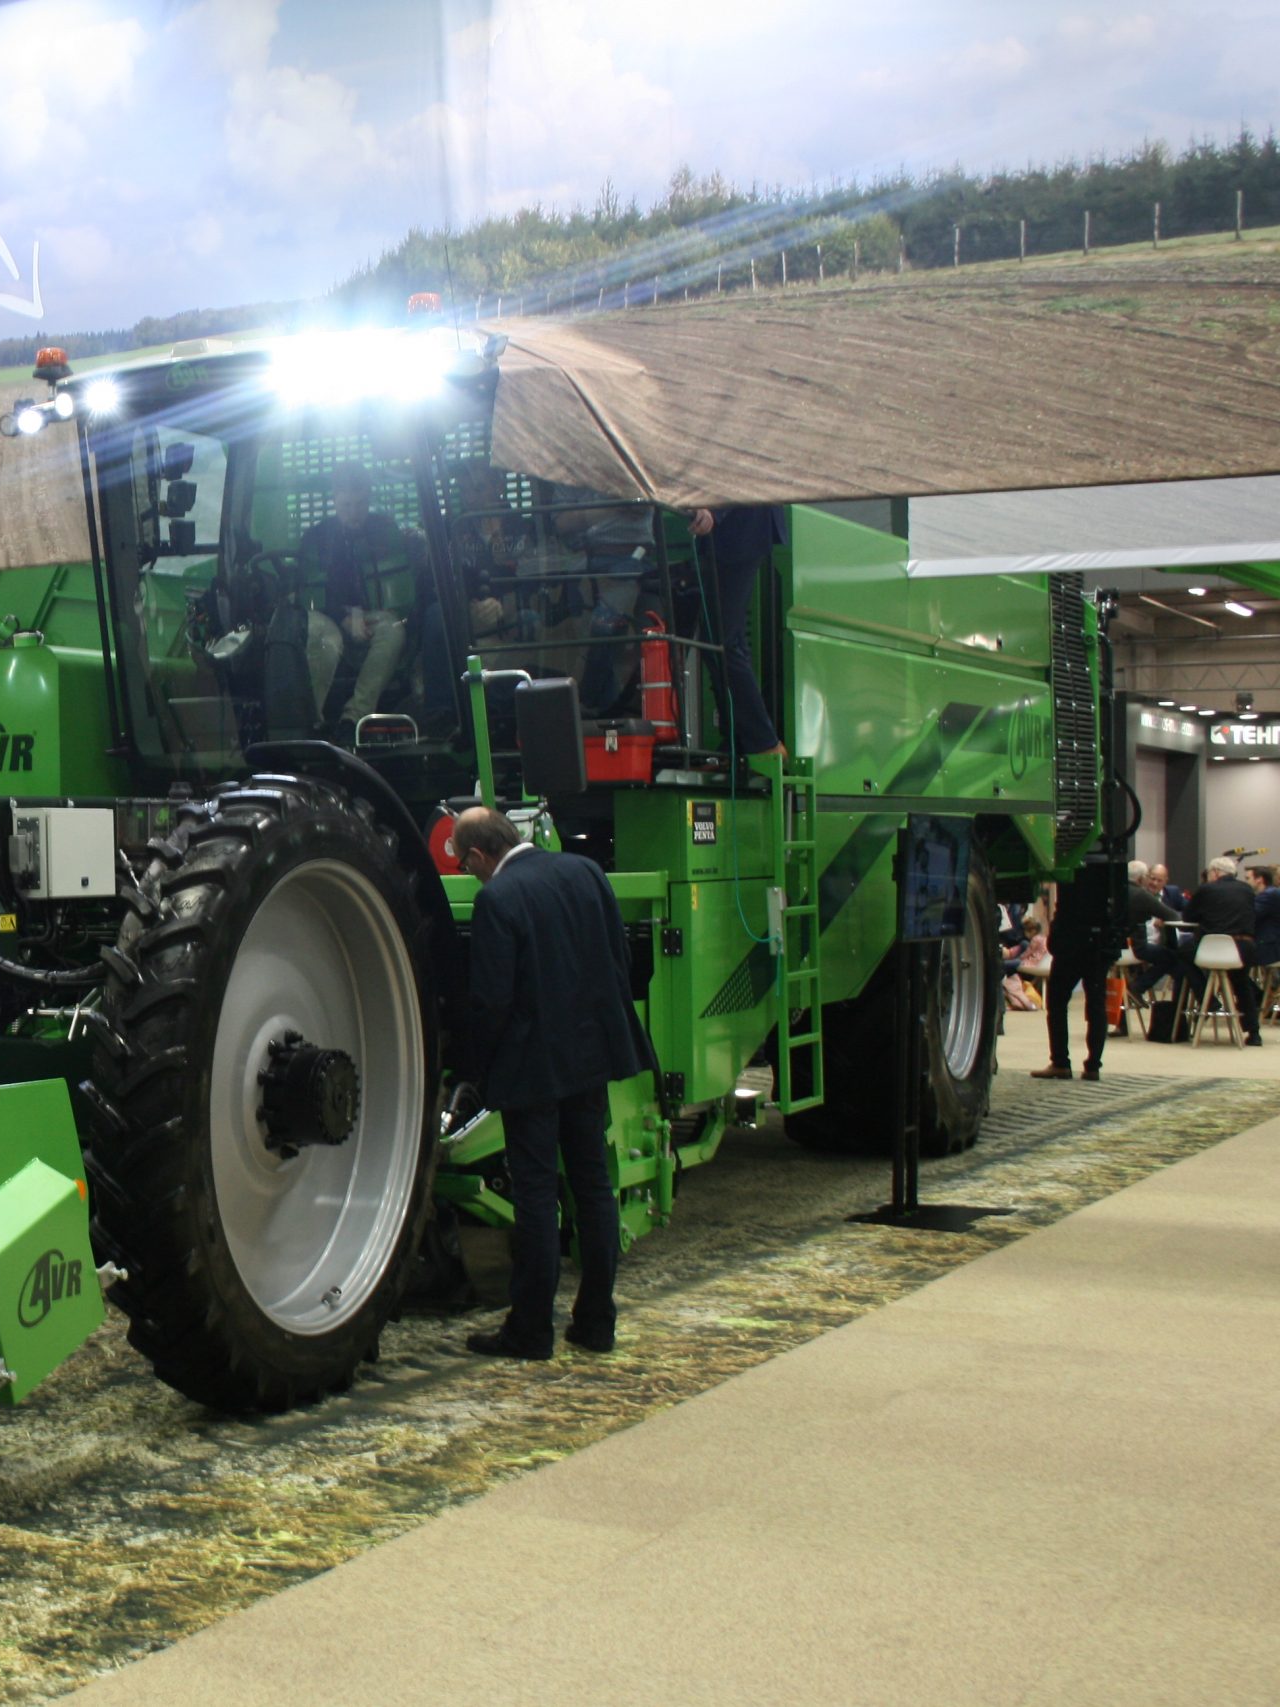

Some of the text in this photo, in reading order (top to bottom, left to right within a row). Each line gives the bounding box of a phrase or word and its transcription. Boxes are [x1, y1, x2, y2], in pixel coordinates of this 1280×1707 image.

[694, 822, 714, 831] VOLVO
[694, 831, 715, 840] PENTA
[18, 1249, 82, 1328] AVR
